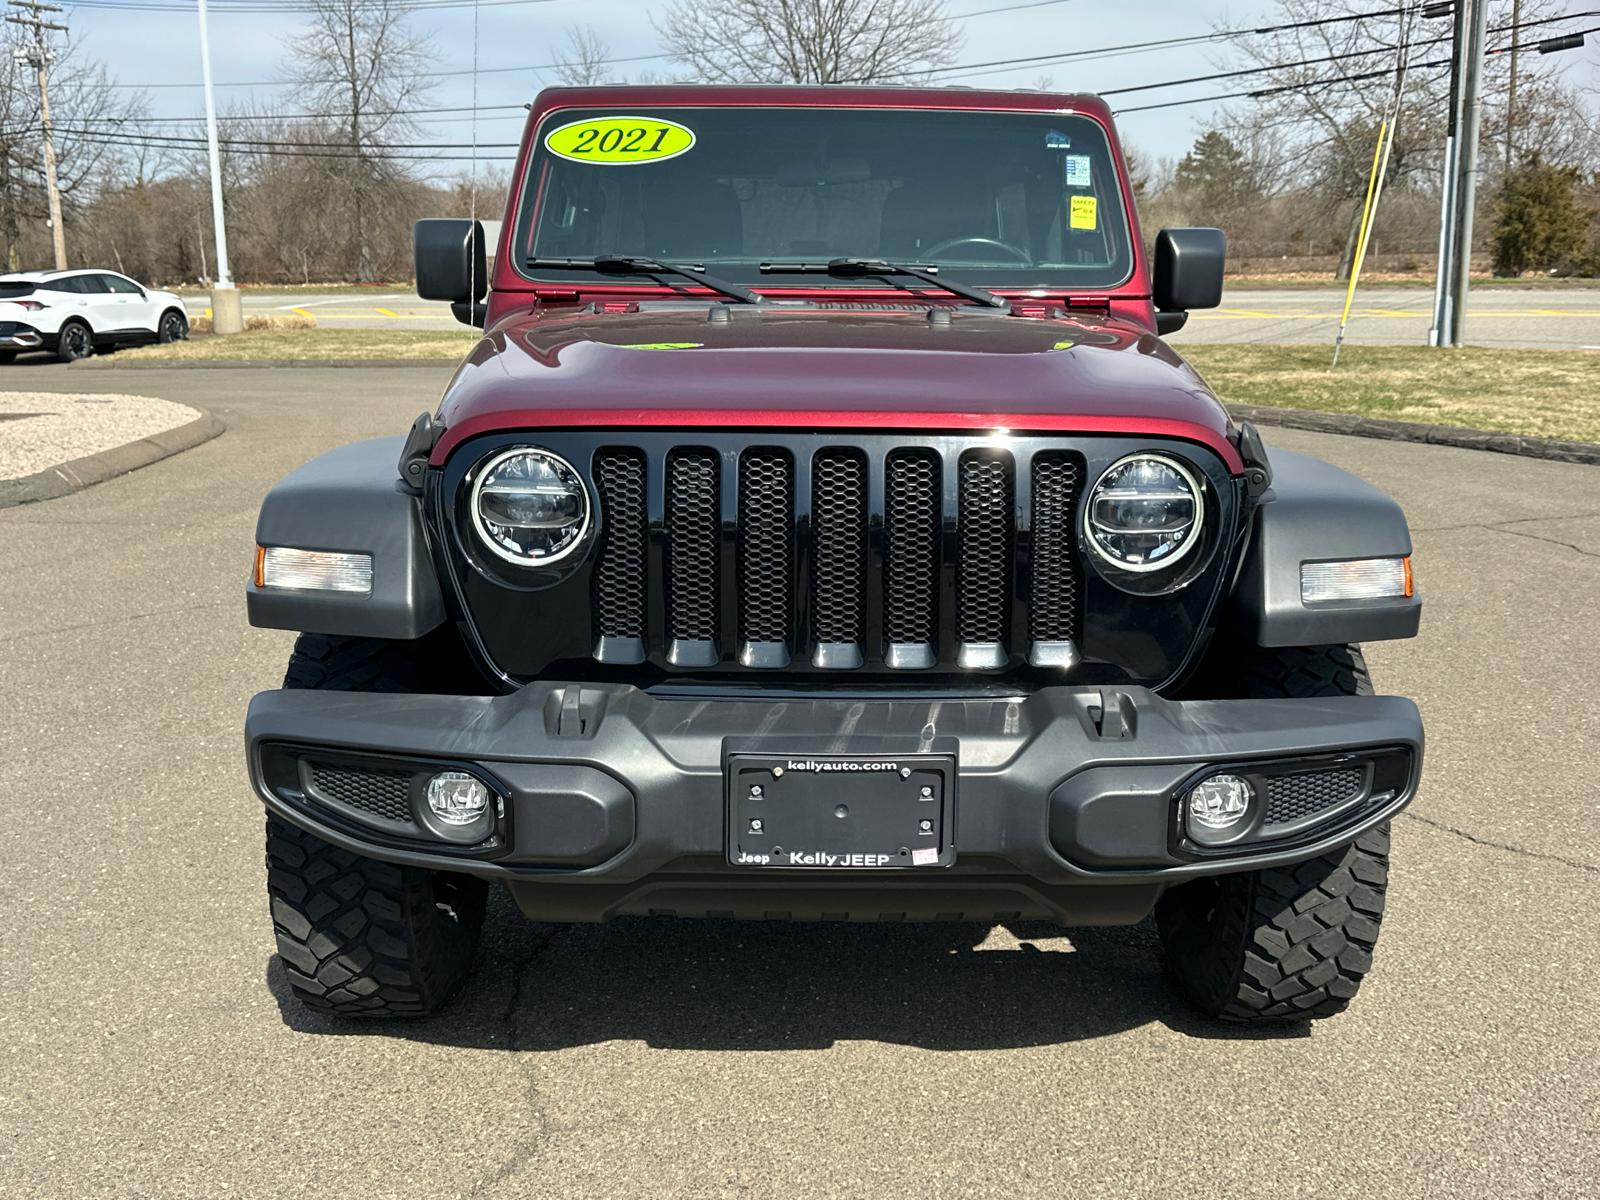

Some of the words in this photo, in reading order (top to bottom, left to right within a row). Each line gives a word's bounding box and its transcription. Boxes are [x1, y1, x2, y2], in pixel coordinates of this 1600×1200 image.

[570, 128, 670, 153] 2021
[787, 760, 898, 773] kellyauto.com
[738, 852, 770, 865] Jeep
[790, 851, 837, 867] Kelly
[839, 854, 890, 867] JEEP
